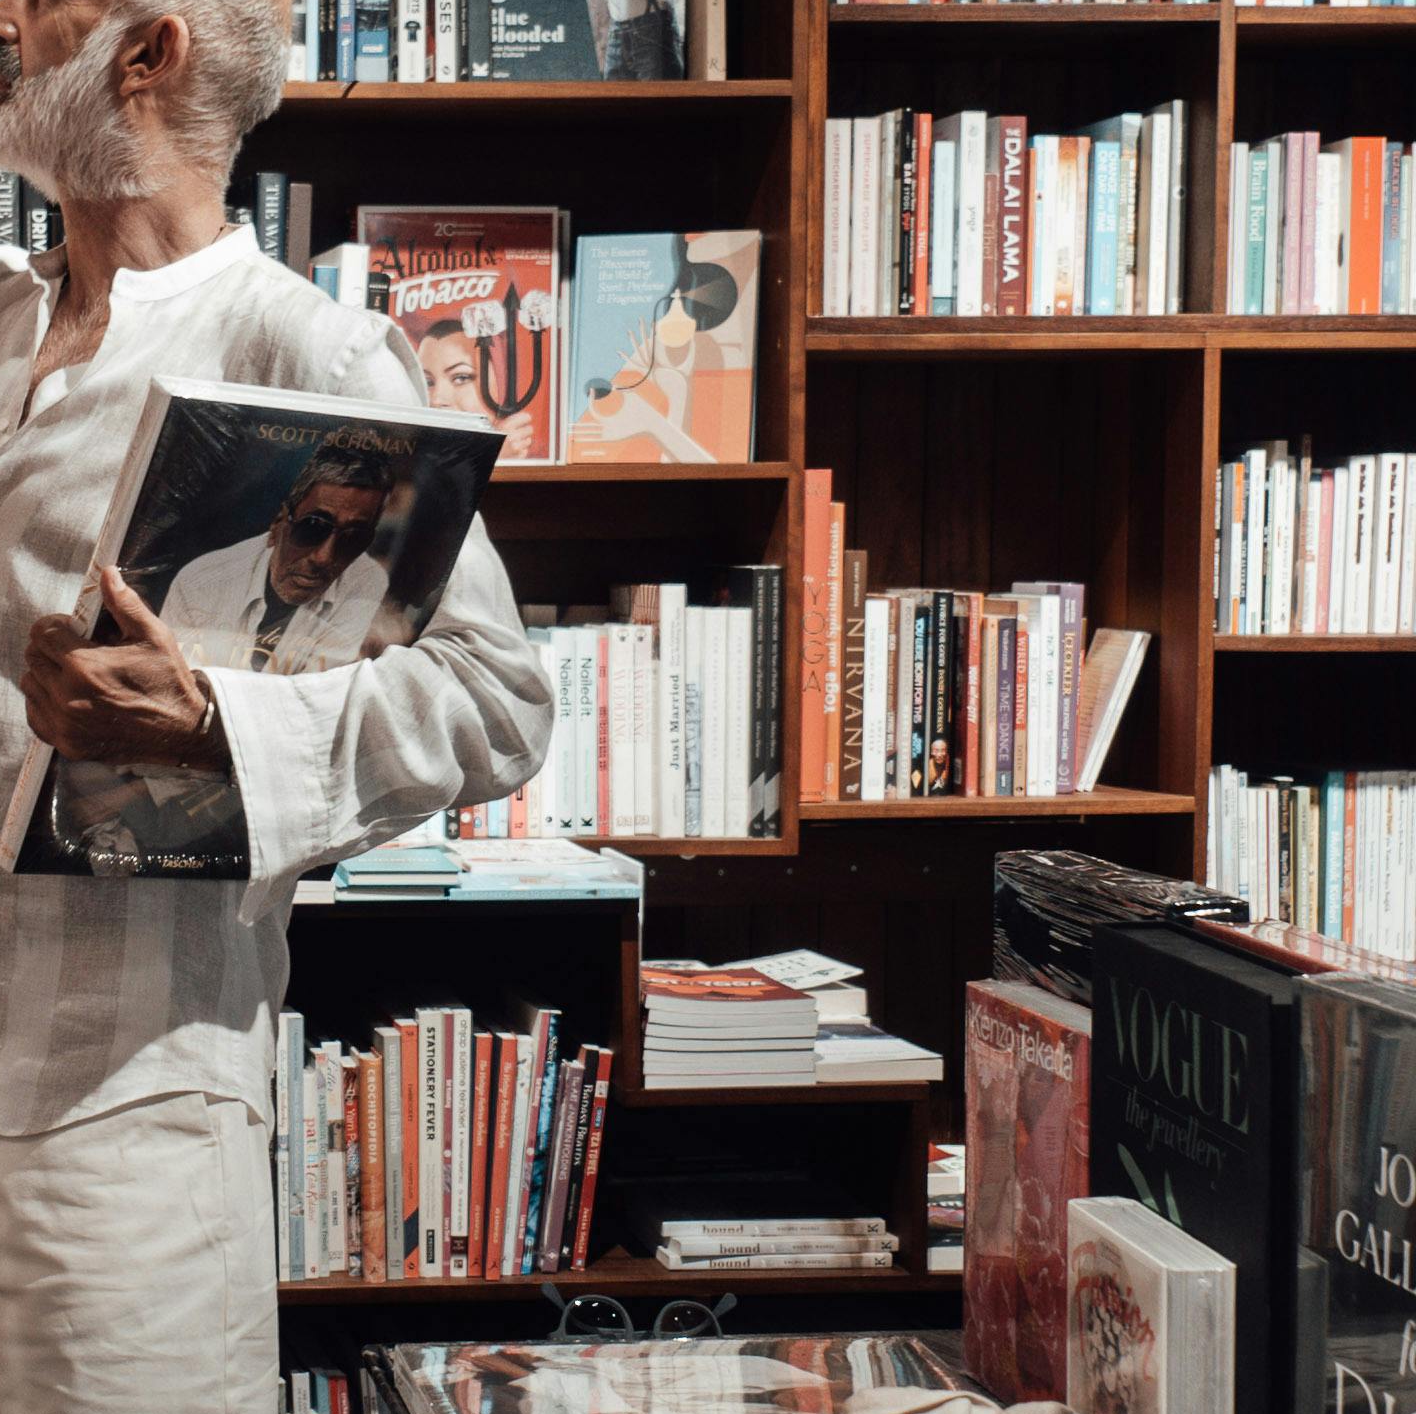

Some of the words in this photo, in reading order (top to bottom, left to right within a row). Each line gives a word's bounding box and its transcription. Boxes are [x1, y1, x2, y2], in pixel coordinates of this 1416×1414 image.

[832, 133, 840, 203] SUPERCHARGE
[862, 133, 872, 202] SUPERCHARGE
[1003, 137, 1021, 208] DALAI
[1251, 159, 1267, 200] Brain
[265, 184, 279, 220] THE
[1248, 204, 1266, 242] Food
[371, 236, 482, 281] Alcohol
[591, 247, 609, 258] The
[831, 234, 839, 254] LIFE
[861, 233, 870, 254] LIFE
[1003, 214, 1021, 283] LAMA
[392, 271, 501, 316] Tobacco
[255, 423, 321, 445] SCOTT
[322, 430, 417, 456] SCHUMAN
[827, 521, 840, 577] Retreats
[827, 581, 841, 638] Spiritual
[914, 617, 924, 637] YOU
[801, 583, 827, 692] YOGA
[829, 640, 839, 667] and
[938, 644, 946, 667] GOOD
[1016, 636, 1027, 673] WIRED
[559, 658, 572, 706] Nailed
[580, 657, 593, 705] Nailed
[824, 670, 839, 715] Yoga
[914, 662, 923, 686] BORN
[669, 673, 680, 732] Married
[843, 616, 864, 771] NIRVANA
[914, 687, 923, 704] FOR
[1000, 683, 1010, 712] TIME
[1015, 683, 1026, 725] DATING
[914, 706, 923, 724] THIS
[936, 697, 945, 734] GOLEMAN
[669, 738, 680, 771] Just
[999, 723, 1010, 761] DANCE
[387, 1044, 399, 1074] using
[968, 1001, 1016, 1053] Kenzo
[1017, 1022, 1074, 1083] Takada
[1103, 971, 1250, 1135] VOGUE
[426, 1026, 436, 1099] STATIONERY
[570, 1076, 580, 1087] The
[389, 1075, 400, 1113] natural
[500, 1074, 510, 1098] Vintage
[569, 1089, 579, 1102] ART
[579, 1084, 594, 1123] BADASS
[318, 1101, 328, 1140] passion
[346, 1108, 356, 1131] Yarn
[366, 1068, 378, 1164] CROCHETOPEDIA
[390, 1114, 401, 1154] finishes
[426, 1102, 436, 1141] FEVER
[563, 1110, 575, 1139] NAPKIN
[1125, 1085, 1155, 1131] the
[1145, 1113, 1227, 1180] jewellery
[573, 1125, 589, 1166] BRAIDS
[590, 1131, 602, 1148] TEA
[558, 1139, 572, 1181] FOLDING
[585, 1149, 599, 1177] TOWEL
[318, 1159, 328, 1200] Quilting
[702, 1224, 744, 1235] bound
[719, 1242, 761, 1254] bound
[708, 1257, 751, 1269] bound
